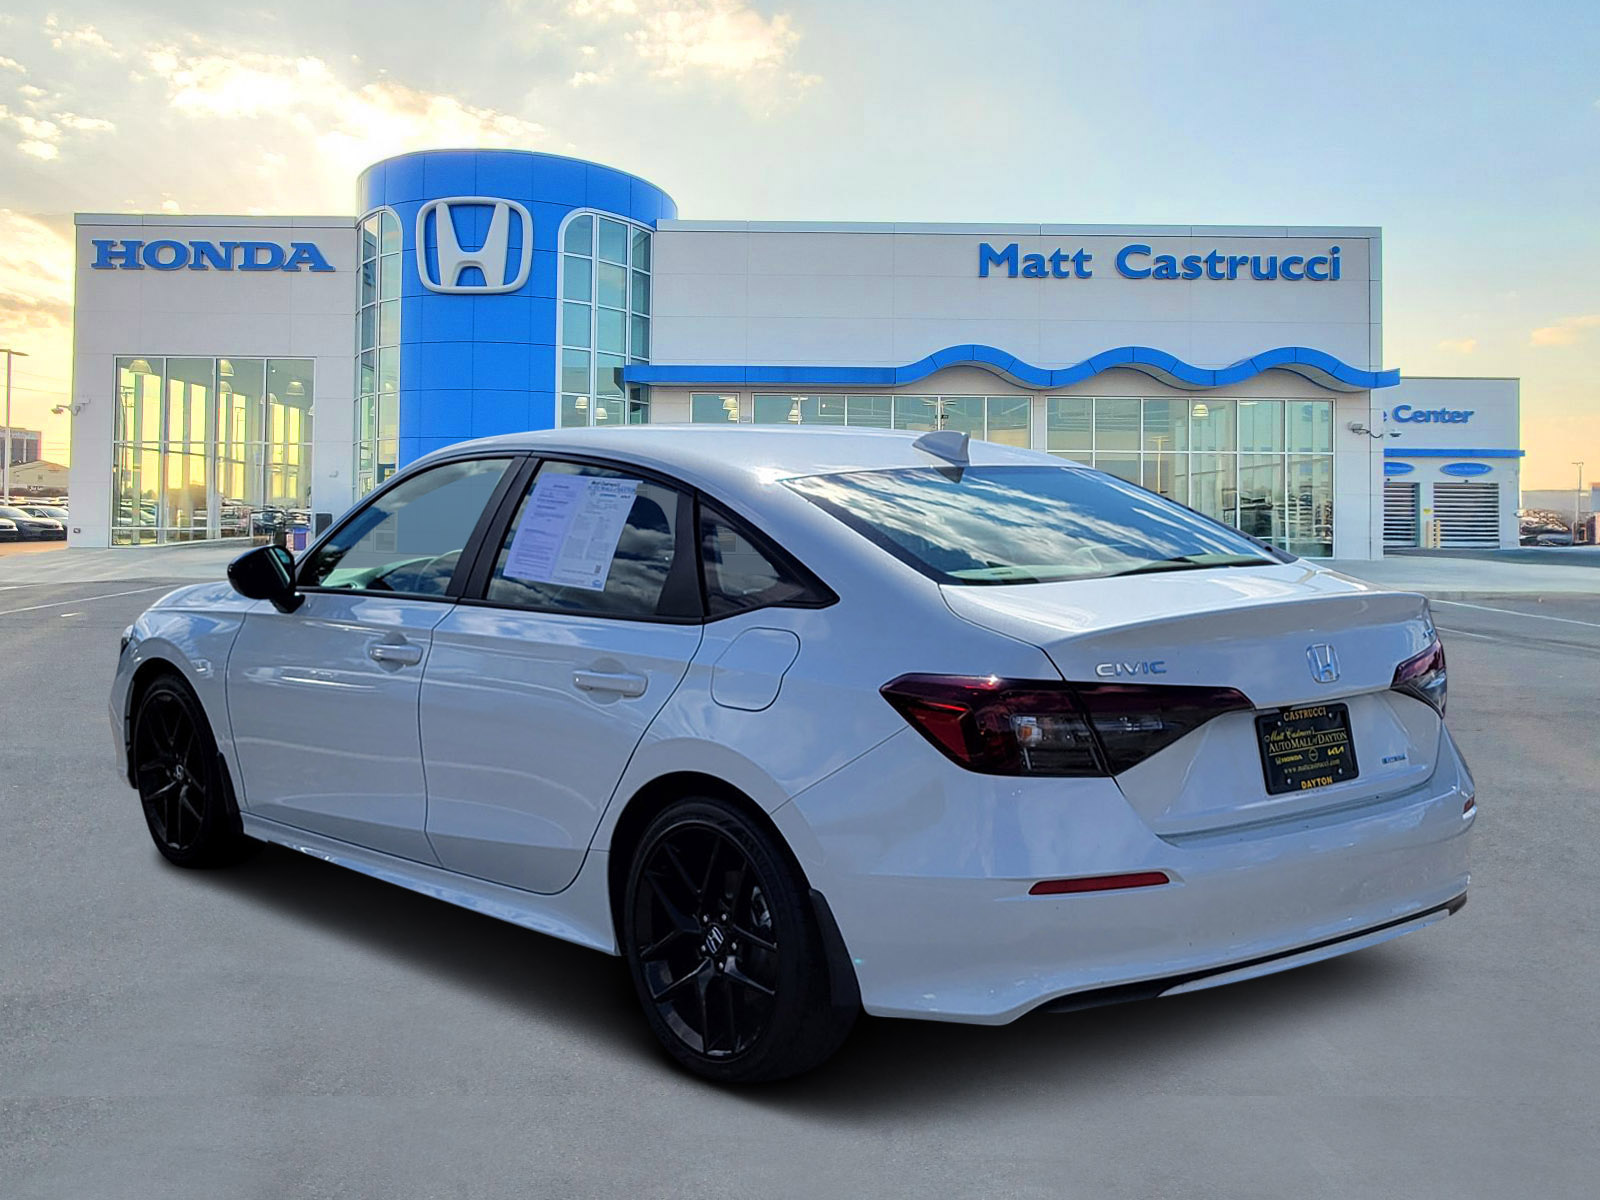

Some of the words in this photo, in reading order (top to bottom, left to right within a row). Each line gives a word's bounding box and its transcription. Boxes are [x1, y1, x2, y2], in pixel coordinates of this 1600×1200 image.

[91, 239, 336, 272] HONDA
[978, 242, 1093, 279] Matt
[1116, 243, 1342, 282] Castrucci
[1392, 404, 1475, 424] Center
[1095, 661, 1167, 677] CIVIC
[1283, 706, 1327, 721] CASTRUCCI
[1300, 776, 1334, 790] DAYTON
